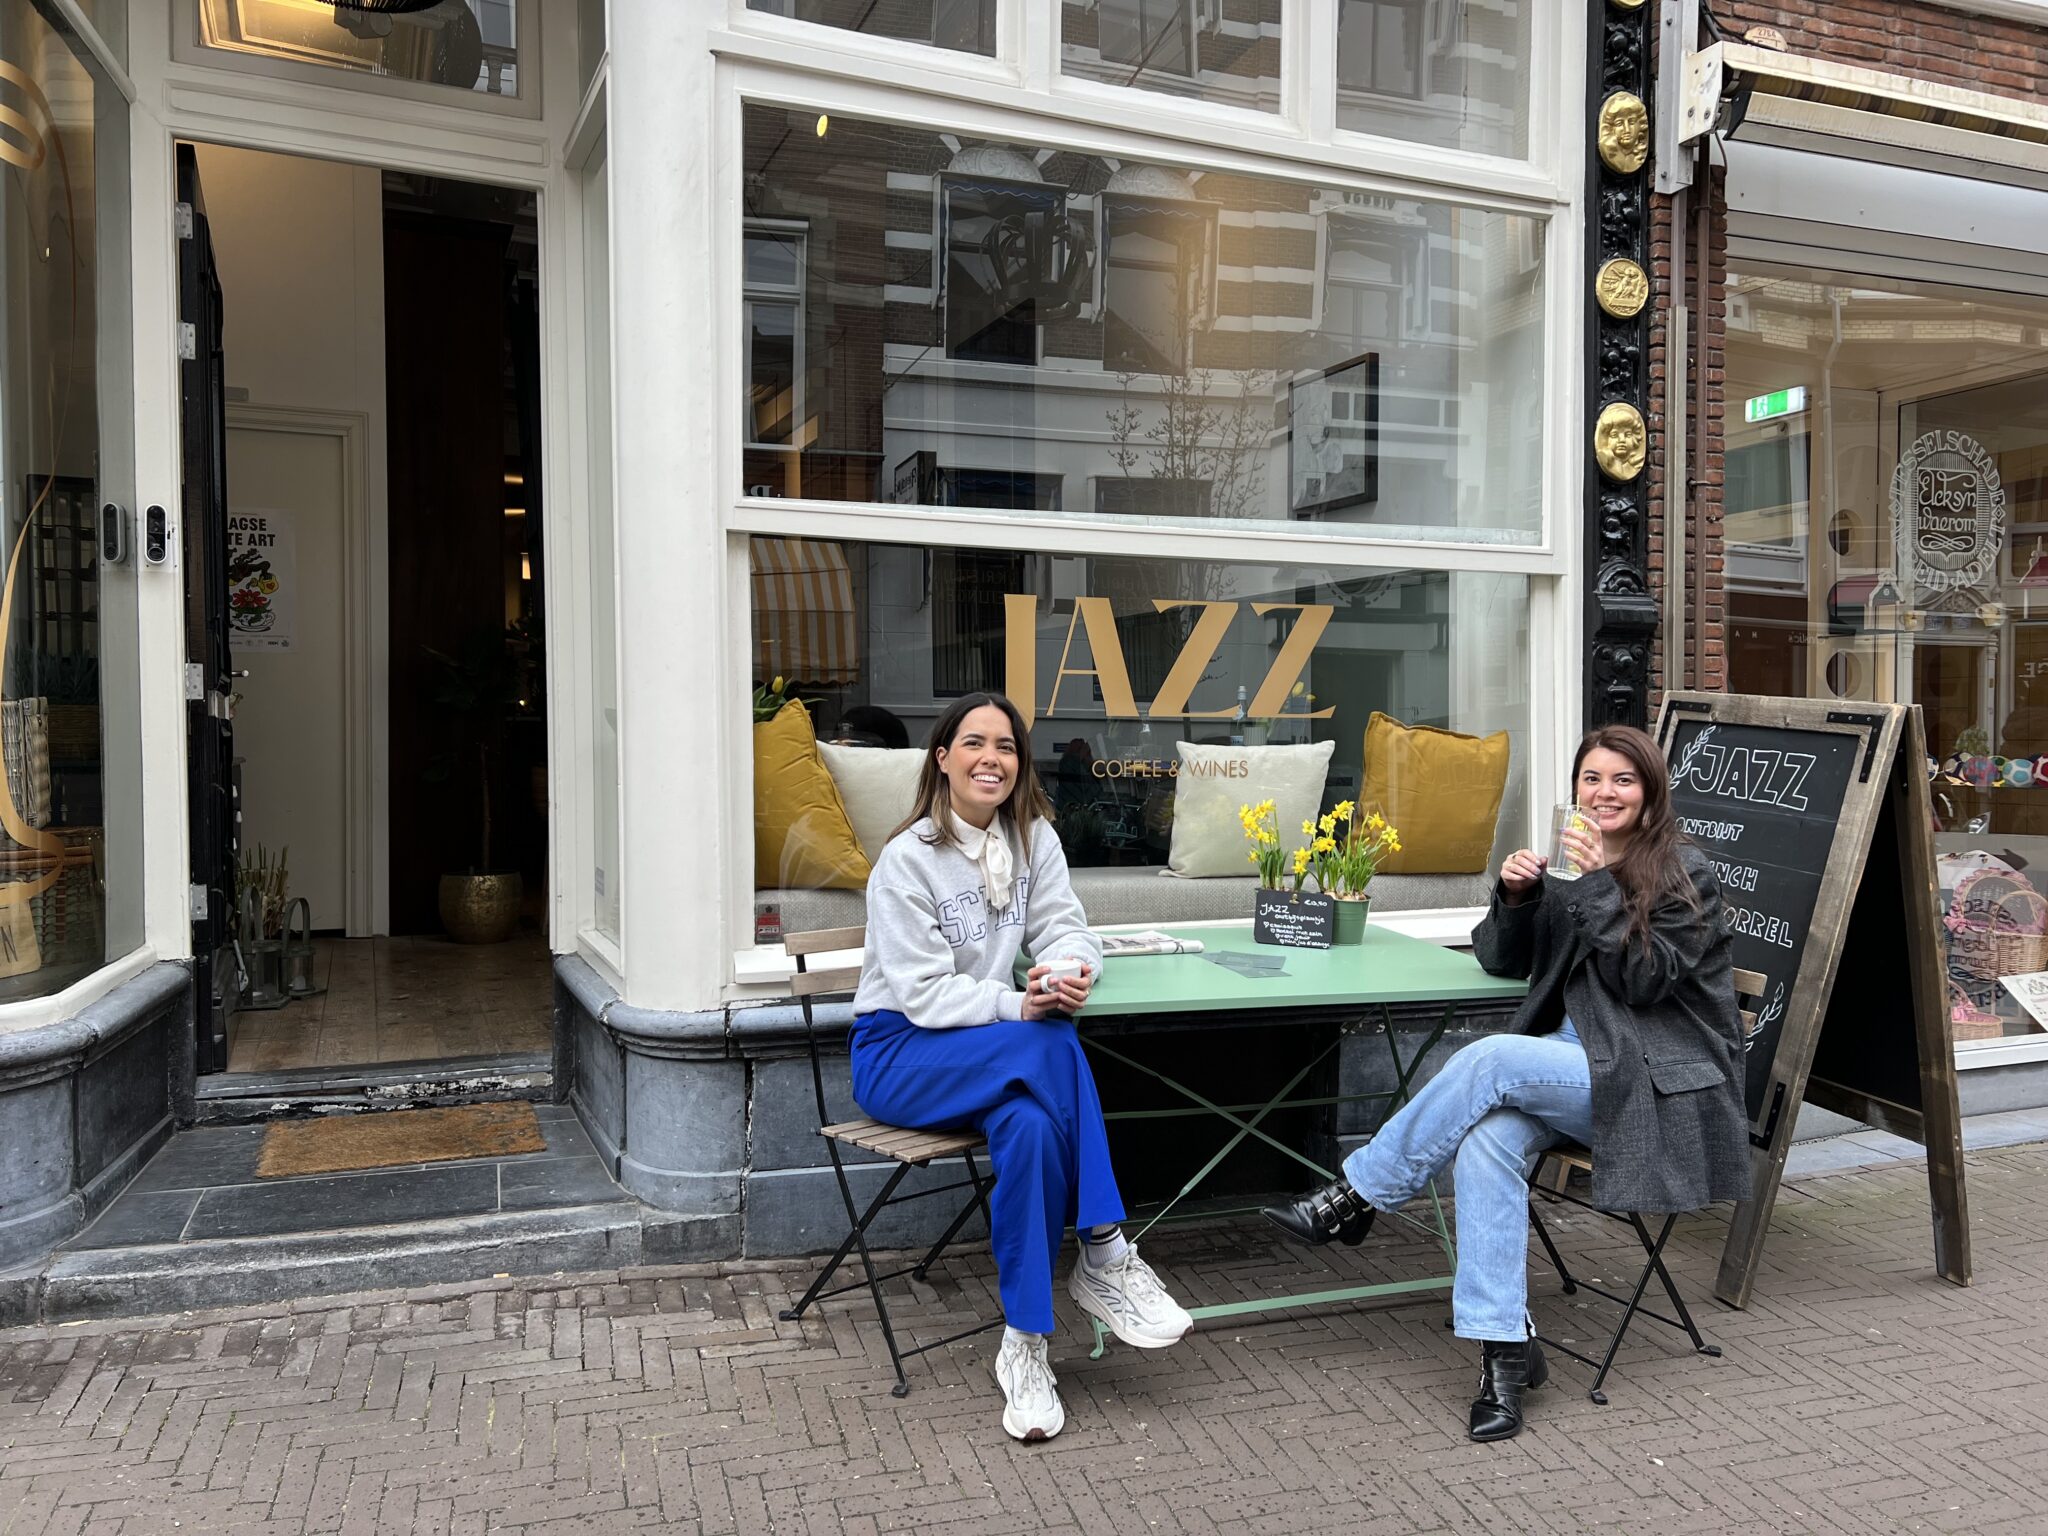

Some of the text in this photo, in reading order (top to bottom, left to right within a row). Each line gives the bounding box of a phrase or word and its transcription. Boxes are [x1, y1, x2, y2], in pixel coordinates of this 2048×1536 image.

[248, 533, 276, 547] ART
[1004, 593, 1337, 734] JAZZ
[1092, 759, 1249, 779] COFFEE & WINES
[1690, 745, 1816, 811] JAZZ
[1260, 902, 1290, 916] JAZZ
